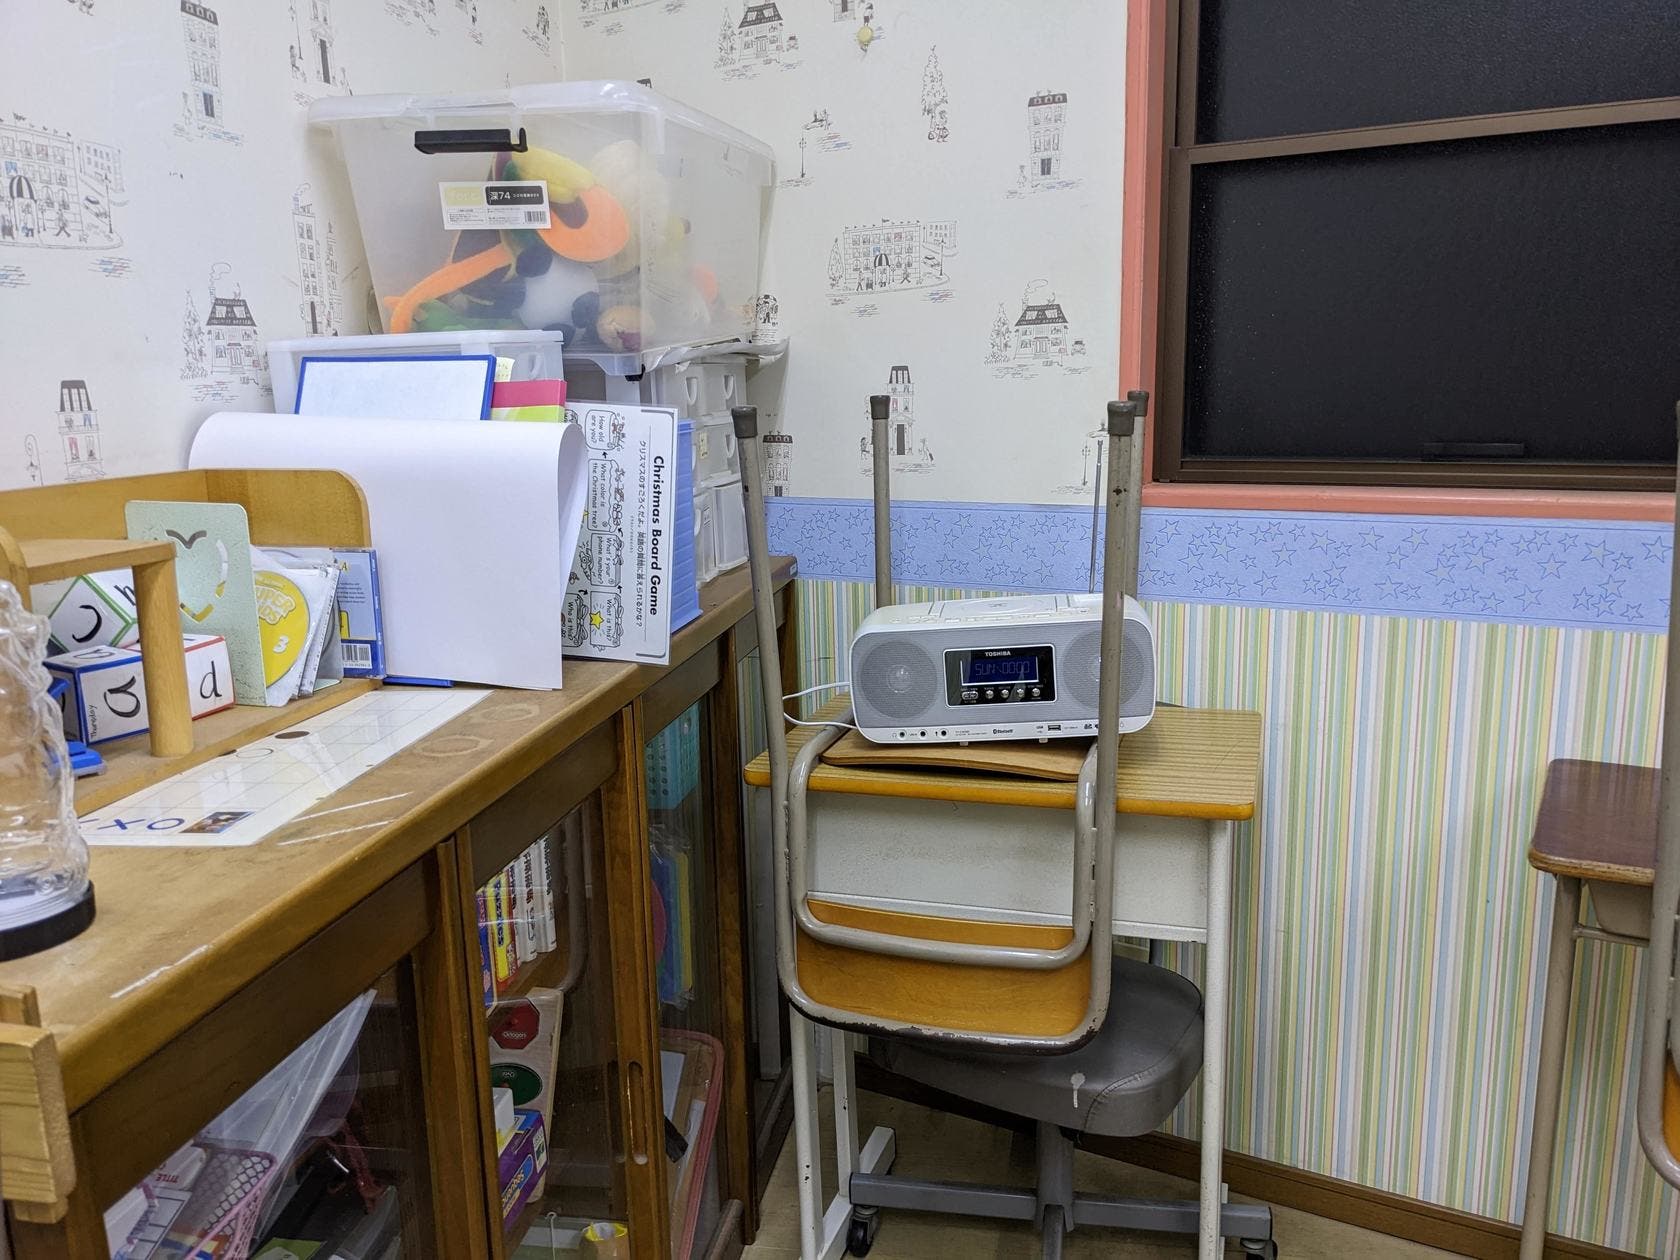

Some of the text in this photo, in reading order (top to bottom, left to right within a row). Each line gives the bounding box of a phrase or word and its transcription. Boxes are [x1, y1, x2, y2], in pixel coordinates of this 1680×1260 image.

[590, 428, 598, 444] you?
[598, 432, 606, 442] old
[650, 455, 665, 616] Christmas Board Game
